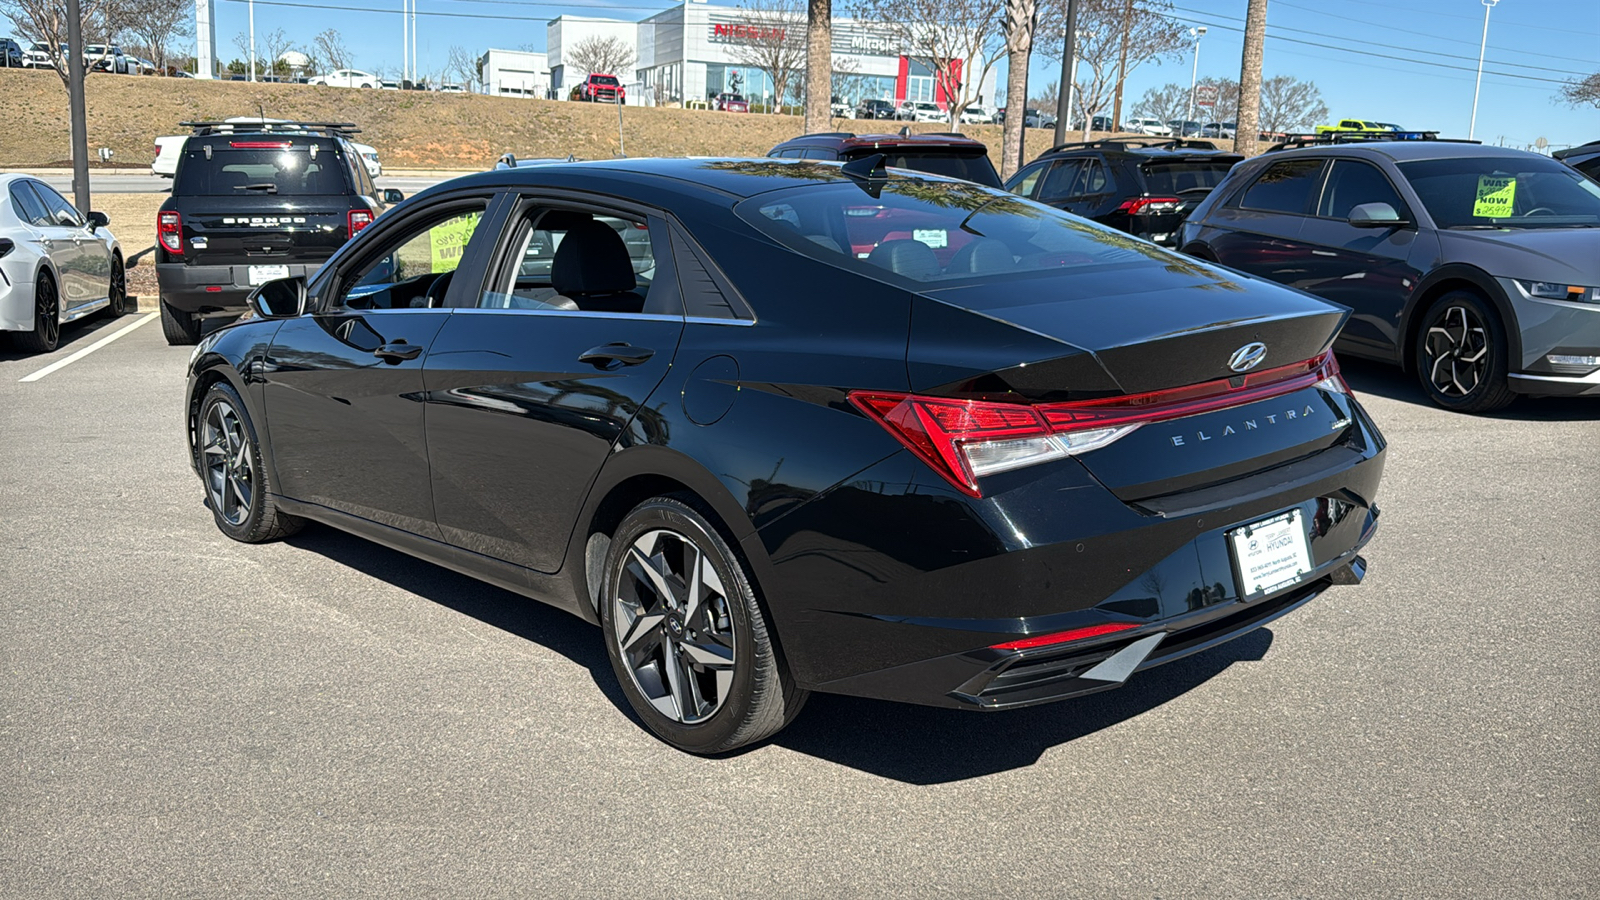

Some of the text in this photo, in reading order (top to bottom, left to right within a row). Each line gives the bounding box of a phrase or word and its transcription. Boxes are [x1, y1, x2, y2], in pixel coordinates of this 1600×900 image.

[714, 23, 786, 41] NISSAN
[851, 36, 897, 51] Miracle
[1483, 179, 1510, 187] WAS
[1170, 404, 1315, 447] ELANTRA
[1266, 536, 1293, 552] HYUNDAI
